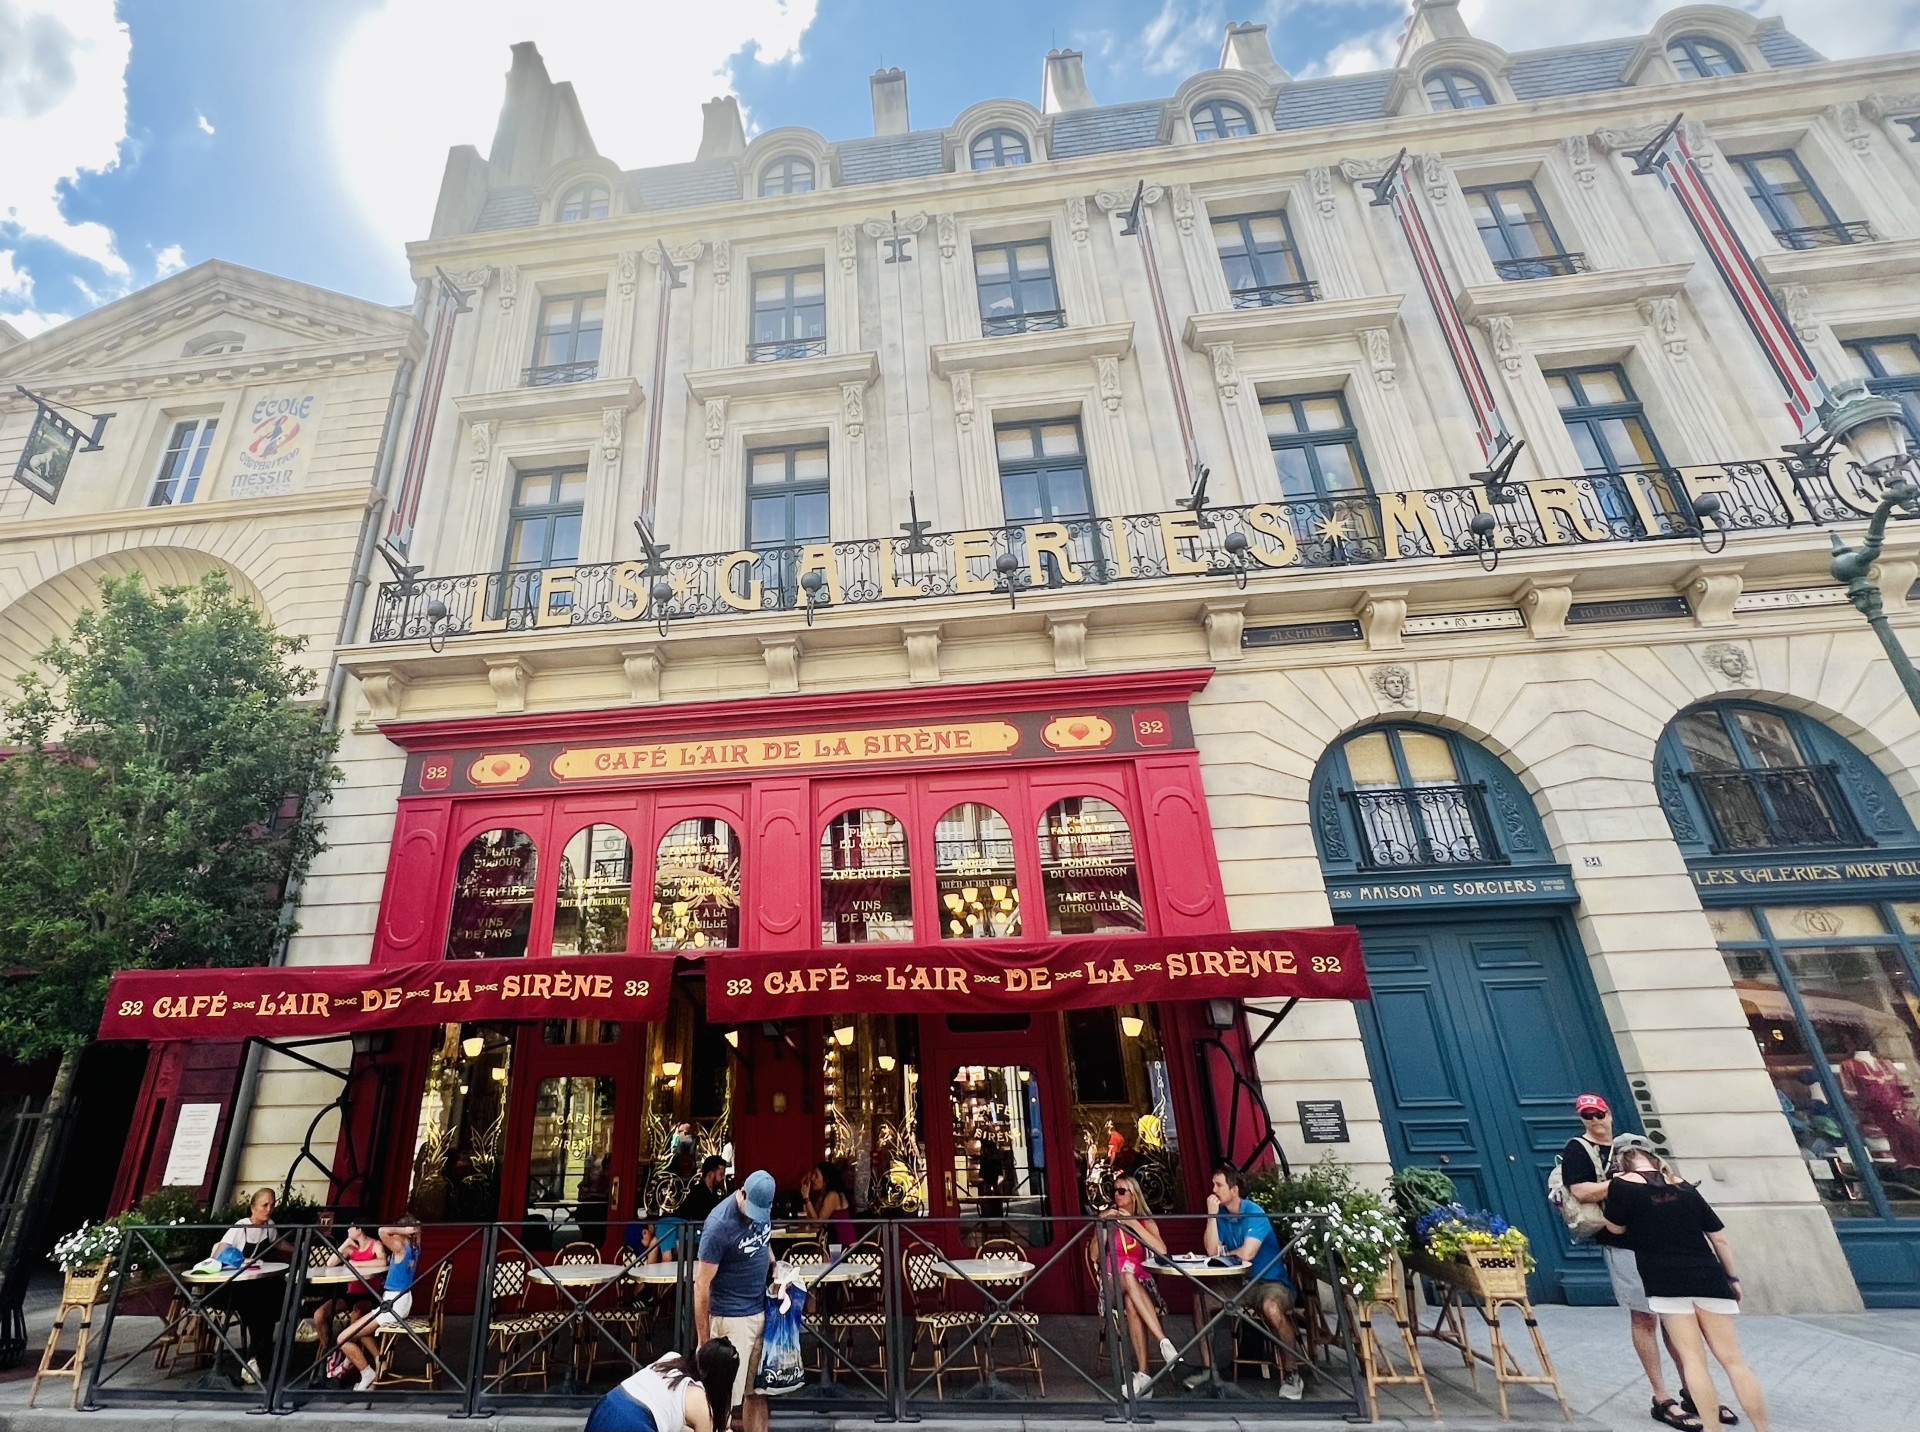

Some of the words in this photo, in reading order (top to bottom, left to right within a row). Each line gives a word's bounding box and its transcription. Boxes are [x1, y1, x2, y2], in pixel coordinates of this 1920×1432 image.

[471, 561, 650, 632] LES
[718, 504, 1298, 611] GALERIES
[1139, 720, 1163, 735] 32
[595, 746, 667, 771] CAFÉ
[680, 744, 749, 766] L'AIR
[763, 741, 801, 760] DE
[815, 737, 851, 757] LA
[864, 729, 972, 756] SIRÈNE
[426, 766, 448, 780] 32
[849, 828, 879, 837] PLAT
[1051, 825, 1092, 835] FAVORIS
[1094, 824, 1115, 833] DES
[840, 840, 855, 849] DU
[859, 838, 890, 848] JOUR
[485, 847, 511, 857] PLAT
[1061, 857, 1113, 867] FONDANT
[1050, 869, 1065, 879] DU
[1068, 867, 1127, 878] CHAUDRON
[1695, 870, 1738, 885] LES
[1740, 865, 1842, 883] GALERIES
[674, 877, 721, 886] FONDANT
[662, 888, 676, 897] DU
[679, 886, 733, 896] CHAUDRON
[1360, 885, 1422, 900] MAISON
[1429, 885, 1446, 895] DE
[1453, 879, 1537, 897] SORCIERS
[1058, 891, 1096, 902] TARTE
[1110, 890, 1126, 900] LA
[852, 900, 881, 911] VINS
[1058, 901, 1129, 913] CITROUILLE
[713, 908, 727, 917] LA
[841, 913, 859, 923] DE
[863, 912, 893, 922] PAYS
[477, 917, 503, 928] VINS
[484, 928, 512, 938] PAYS
[726, 978, 752, 996] 32
[764, 963, 850, 995] CAFÉ
[886, 964, 971, 994] L'AIR
[1004, 967, 1052, 992] DE
[1085, 959, 1134, 985] LA
[1166, 947, 1298, 979] SIRÈNE
[1311, 956, 1342, 973] 32
[118, 1000, 143, 1016] 32
[153, 991, 228, 1018] CAFÉ
[256, 991, 330, 1017] L'AIR
[361, 987, 403, 1012] DE
[432, 979, 472, 1004] LA
[501, 970, 613, 1001] SIRÈNE
[623, 981, 650, 996] 32
